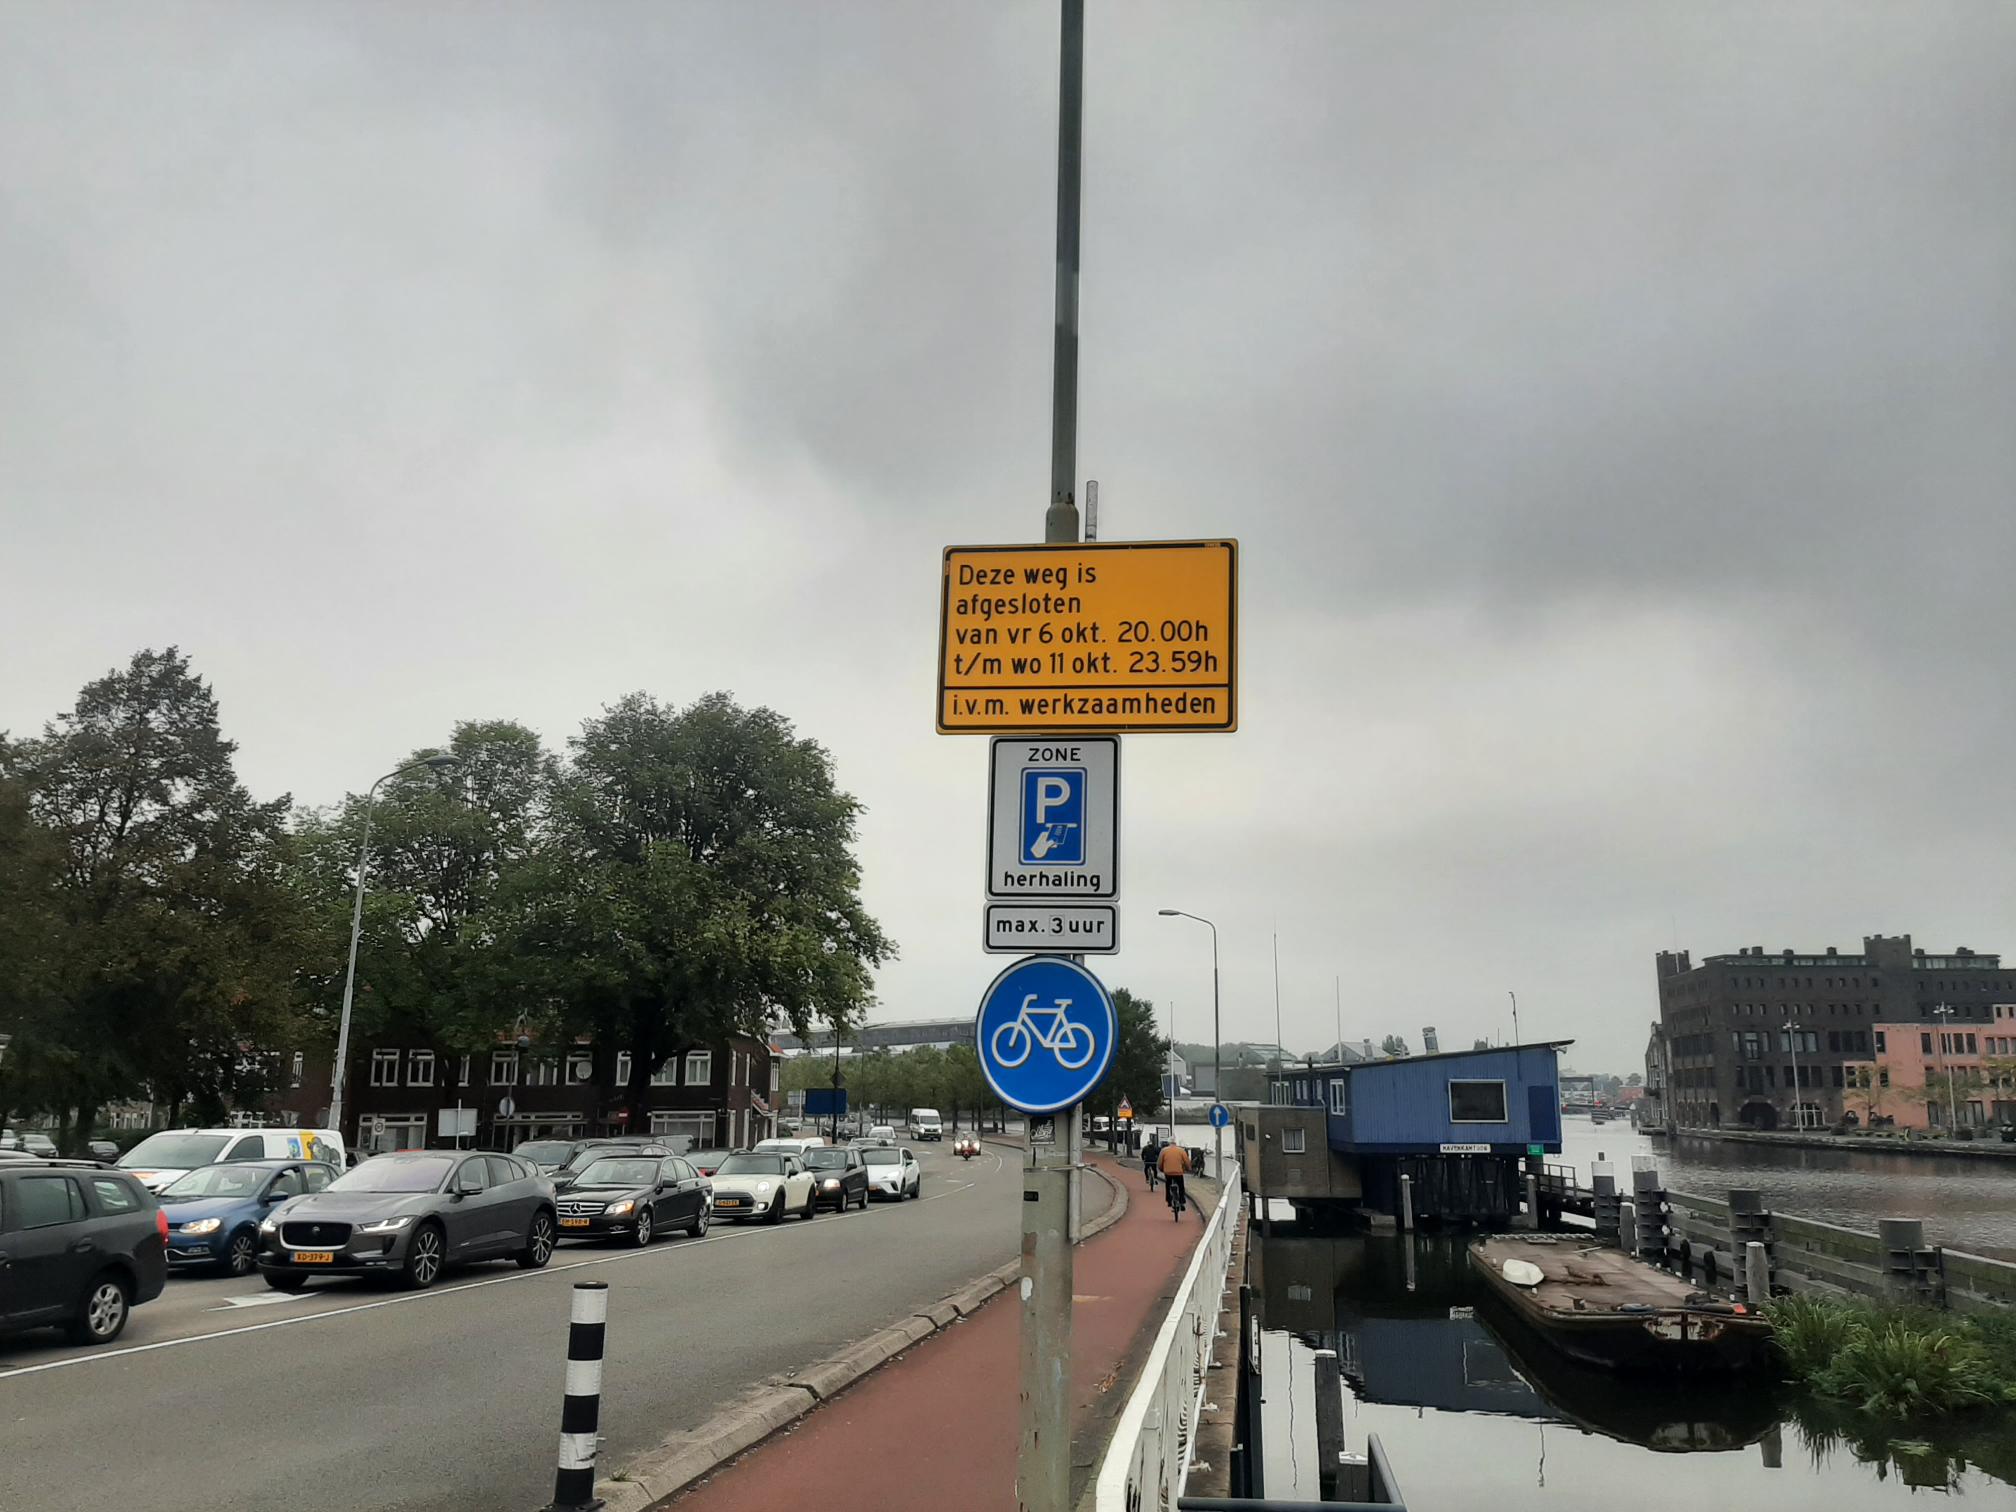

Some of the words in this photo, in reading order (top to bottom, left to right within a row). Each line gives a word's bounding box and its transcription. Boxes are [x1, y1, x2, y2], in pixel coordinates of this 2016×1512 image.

[959, 564, 1015, 586] Deze
[1023, 567, 1068, 591] weg
[1077, 562, 1097, 584] is
[956, 592, 1081, 622] afgesloten
[955, 627, 998, 645] van
[1007, 627, 1032, 645] vr
[1038, 622, 1054, 644] 6
[1061, 621, 1106, 644] okt.
[1117, 619, 1208, 643] 20.00h
[953, 652, 1002, 676] t/m
[1011, 657, 1042, 675] wo
[1049, 652, 1064, 674] 11
[1072, 651, 1118, 674] okt.
[1128, 649, 1218, 674] 23.59h
[952, 694, 1009, 716] i.v.m.
[1019, 691, 1216, 716] werkzaamheden
[1028, 747, 1081, 762] ZONE
[1036, 777, 1071, 824] P
[1004, 871, 1101, 893] herhaling
[996, 919, 1045, 934] max.
[1051, 917, 1063, 934] 3
[1068, 920, 1105, 934] uur
